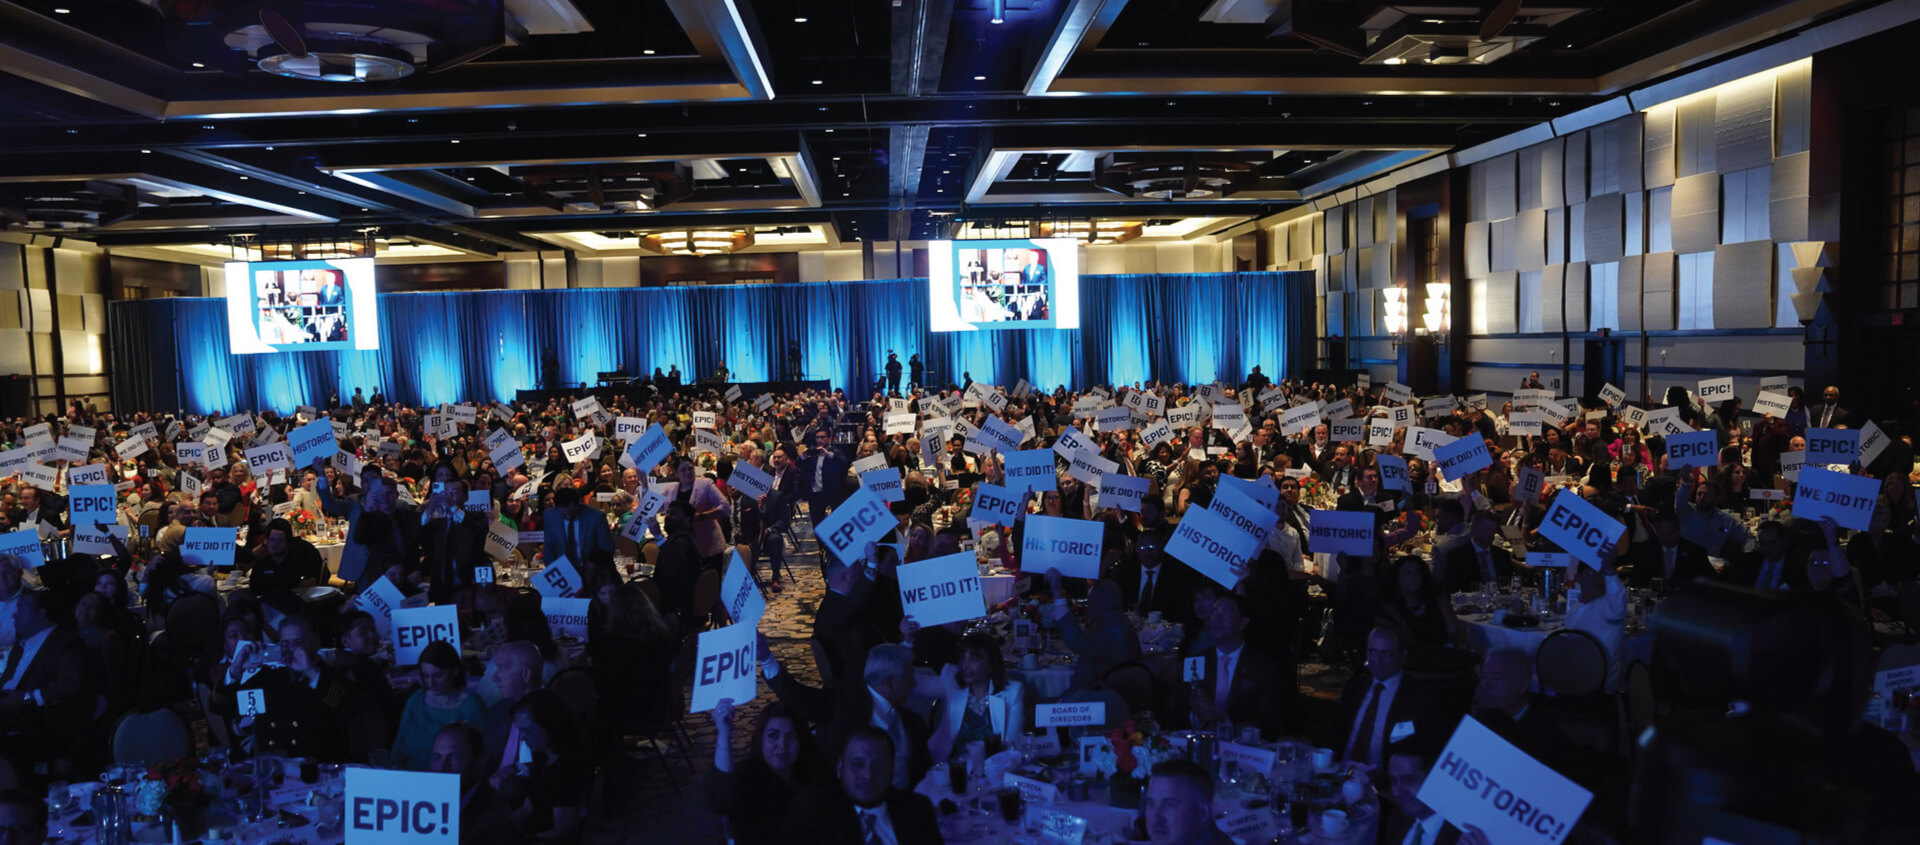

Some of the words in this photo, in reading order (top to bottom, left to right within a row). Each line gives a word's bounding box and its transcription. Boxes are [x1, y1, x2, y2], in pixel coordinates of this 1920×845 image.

[969, 386, 983, 399] EPIC
[1602, 390, 1622, 402] EPIC!
[1701, 384, 1731, 397] EPIC!
[1263, 393, 1283, 407] EPIC!
[1756, 400, 1788, 410] HISTORIC!
[594, 410, 607, 422] PIC!
[931, 403, 947, 416] EPIC!
[1287, 410, 1318, 424] HISTORIC!
[233, 419, 252, 432] EPIC!
[694, 416, 714, 424] EPIC!
[1099, 415, 1129, 423] HISTORIC!
[1131, 416, 1149, 426] EPIC
[1170, 413, 1194, 424] EPIC!
[132, 426, 155, 435] EPIC!
[192, 428, 210, 438] EPIC!
[331, 425, 345, 434] PIC!
[618, 423, 645, 433] EPIC!
[1144, 424, 1170, 444] EPIC!
[1333, 426, 1361, 435] EPIC!
[1372, 426, 1393, 438] EPIC!
[292, 431, 334, 454] HISTORIC!
[697, 435, 721, 450] EPIC!
[982, 424, 1018, 449] HISTORIC!
[1859, 429, 1882, 457] STORIC!
[58, 445, 88, 457] HISTORIC!
[179, 448, 201, 458] EPIC
[567, 437, 595, 456] EPIC!
[634, 433, 666, 465] HISTORIC!
[1670, 441, 1714, 459] EPIC!
[1810, 439, 1855, 454] EPIC!
[250, 450, 284, 467] EPIC!
[495, 448, 519, 466] HISTORIC!
[1440, 458, 1455, 469] WE
[1457, 450, 1472, 462] DID
[1473, 445, 1487, 457] IT!
[1007, 467, 1024, 477] WE
[1026, 466, 1041, 476] DID
[1043, 464, 1055, 474] IT!
[1073, 458, 1102, 477] HISTOR
[733, 469, 769, 493] HISTORIC!
[1102, 485, 1116, 495] WE
[1118, 487, 1133, 497] DID
[1135, 489, 1147, 499] IT!
[1800, 486, 1821, 500] WE
[1825, 491, 1851, 506] DID
[1853, 498, 1874, 511] IT!
[74, 497, 113, 512] EPIC!
[629, 495, 658, 536] EPIC!
[1211, 497, 1268, 541] HISTORIC!
[829, 500, 879, 551] EPIC!
[1311, 526, 1372, 540] HISTORIC!
[186, 541, 202, 550] WE
[203, 541, 221, 551] DID
[222, 540, 234, 550] IT!
[488, 532, 514, 552] TORIC!
[1025, 539, 1099, 557] HISTORIC!
[1176, 523, 1246, 568] HISTORIC!
[0, 543, 40, 558] STORIC!
[544, 566, 575, 599] EPIC
[903, 587, 929, 604] WE
[931, 581, 956, 600] DID
[959, 576, 979, 594] IT!
[364, 588, 392, 619] HISTO
[398, 622, 454, 648] EPIC!
[700, 641, 753, 686] EPIC!
[248, 692, 256, 706] 5
[1052, 706, 1077, 714] BOARD
[1080, 705, 1089, 713] OF
[1050, 715, 1092, 723] DIRECTORS
[1439, 751, 1566, 842] HISTORIC!
[353, 796, 450, 836] EPIC!
